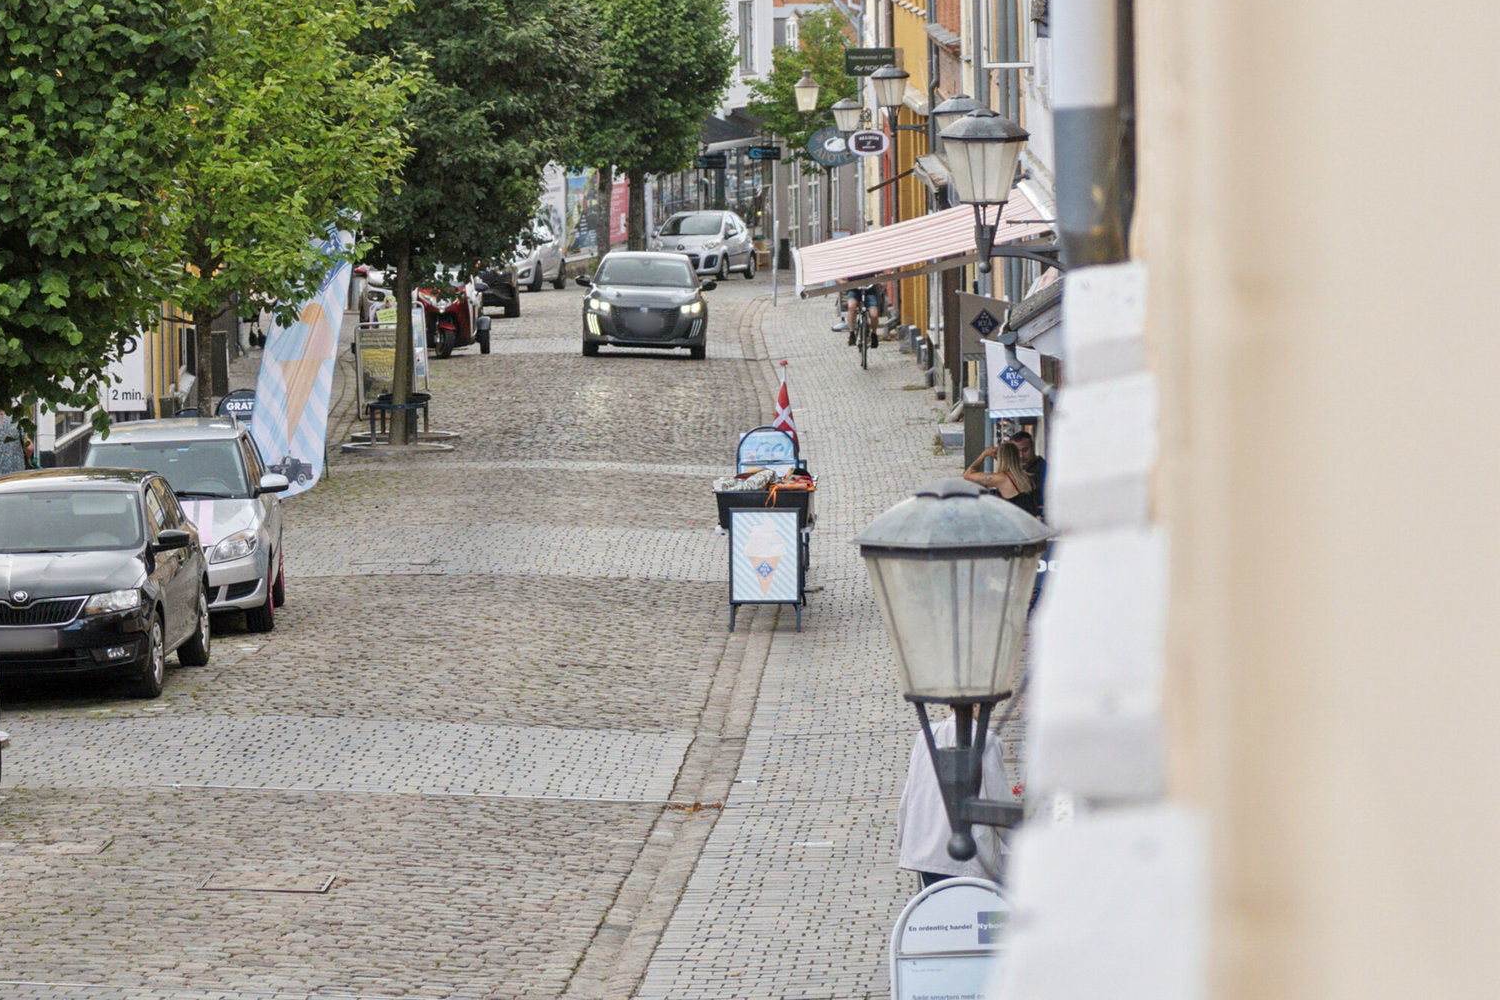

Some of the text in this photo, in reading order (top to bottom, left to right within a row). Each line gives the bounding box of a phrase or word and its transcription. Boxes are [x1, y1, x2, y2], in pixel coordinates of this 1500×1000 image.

[1010, 379, 1019, 387] IS
[112, 389, 145, 400] 2 min.
[918, 924, 949, 932] ordentlig
[949, 923, 973, 931] handel
